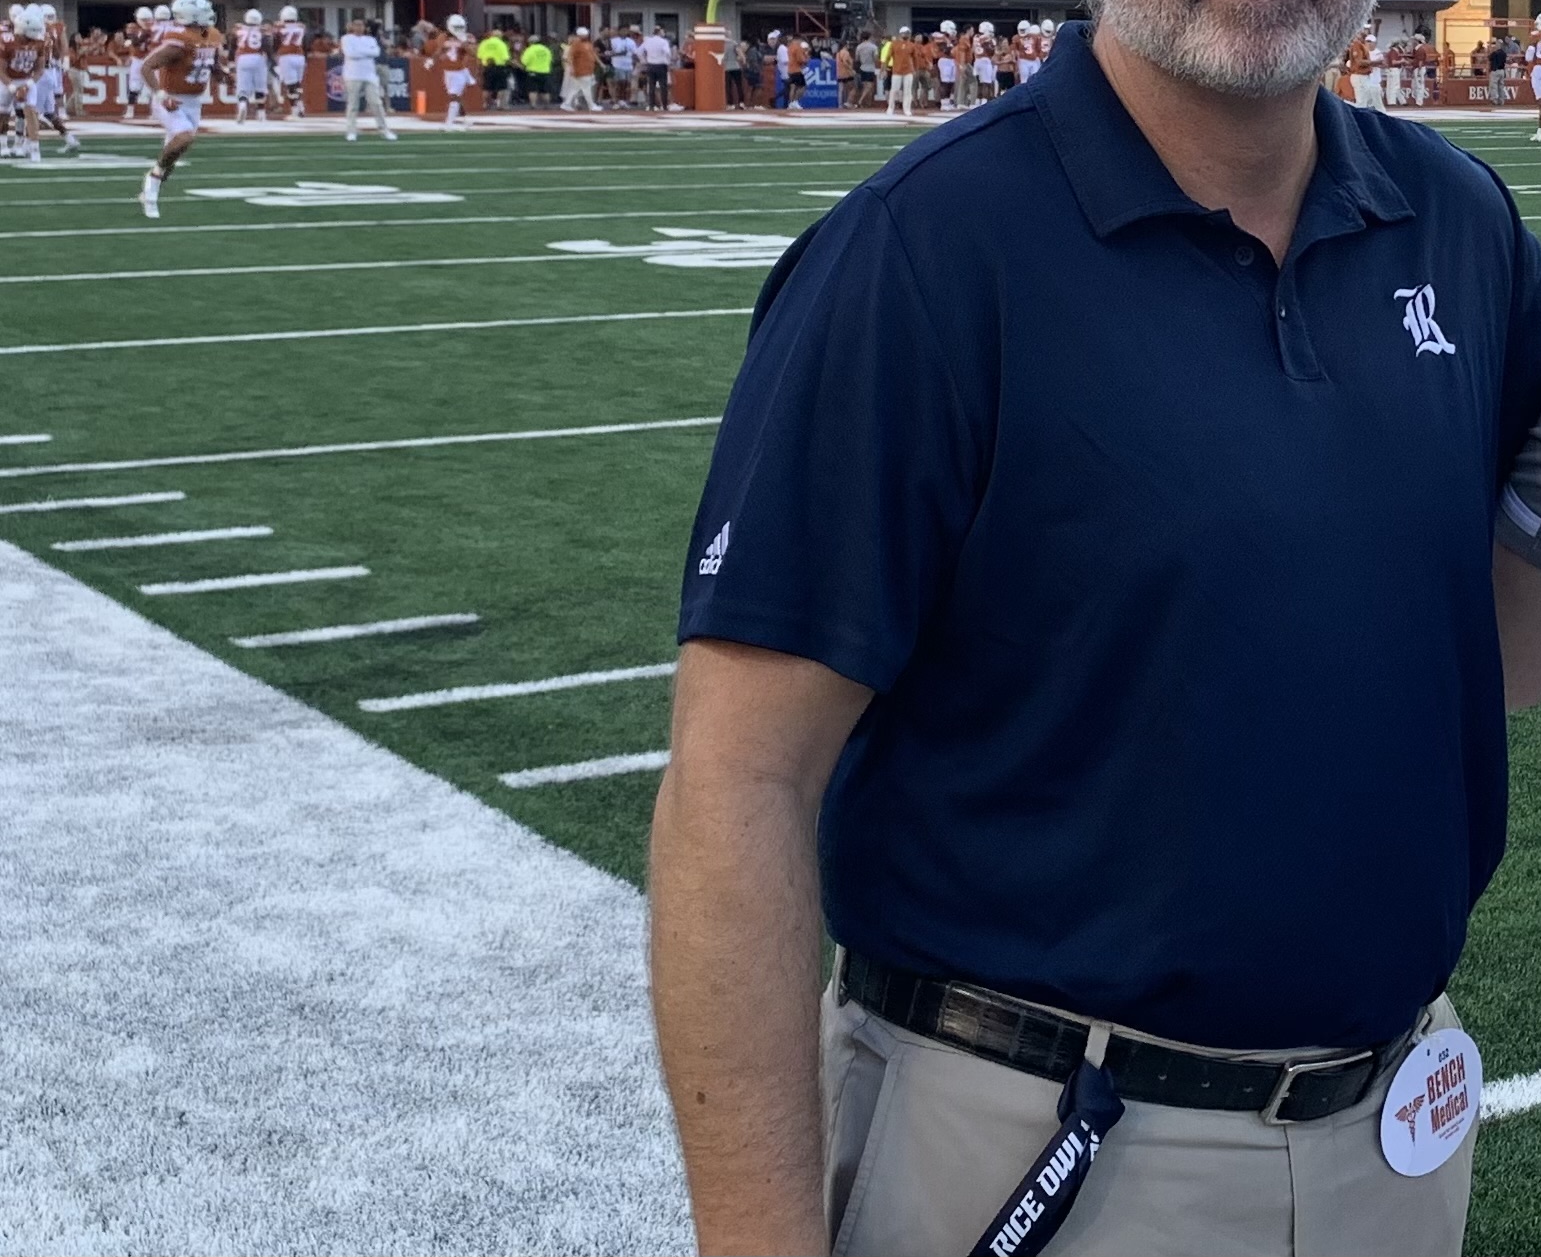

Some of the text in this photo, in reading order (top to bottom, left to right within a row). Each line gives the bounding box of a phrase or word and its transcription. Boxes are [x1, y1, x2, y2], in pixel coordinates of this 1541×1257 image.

[1426, 1052, 1467, 1106] BENCH
[1430, 1083, 1469, 1135] Medical
[989, 1189, 1046, 1257] RICE
